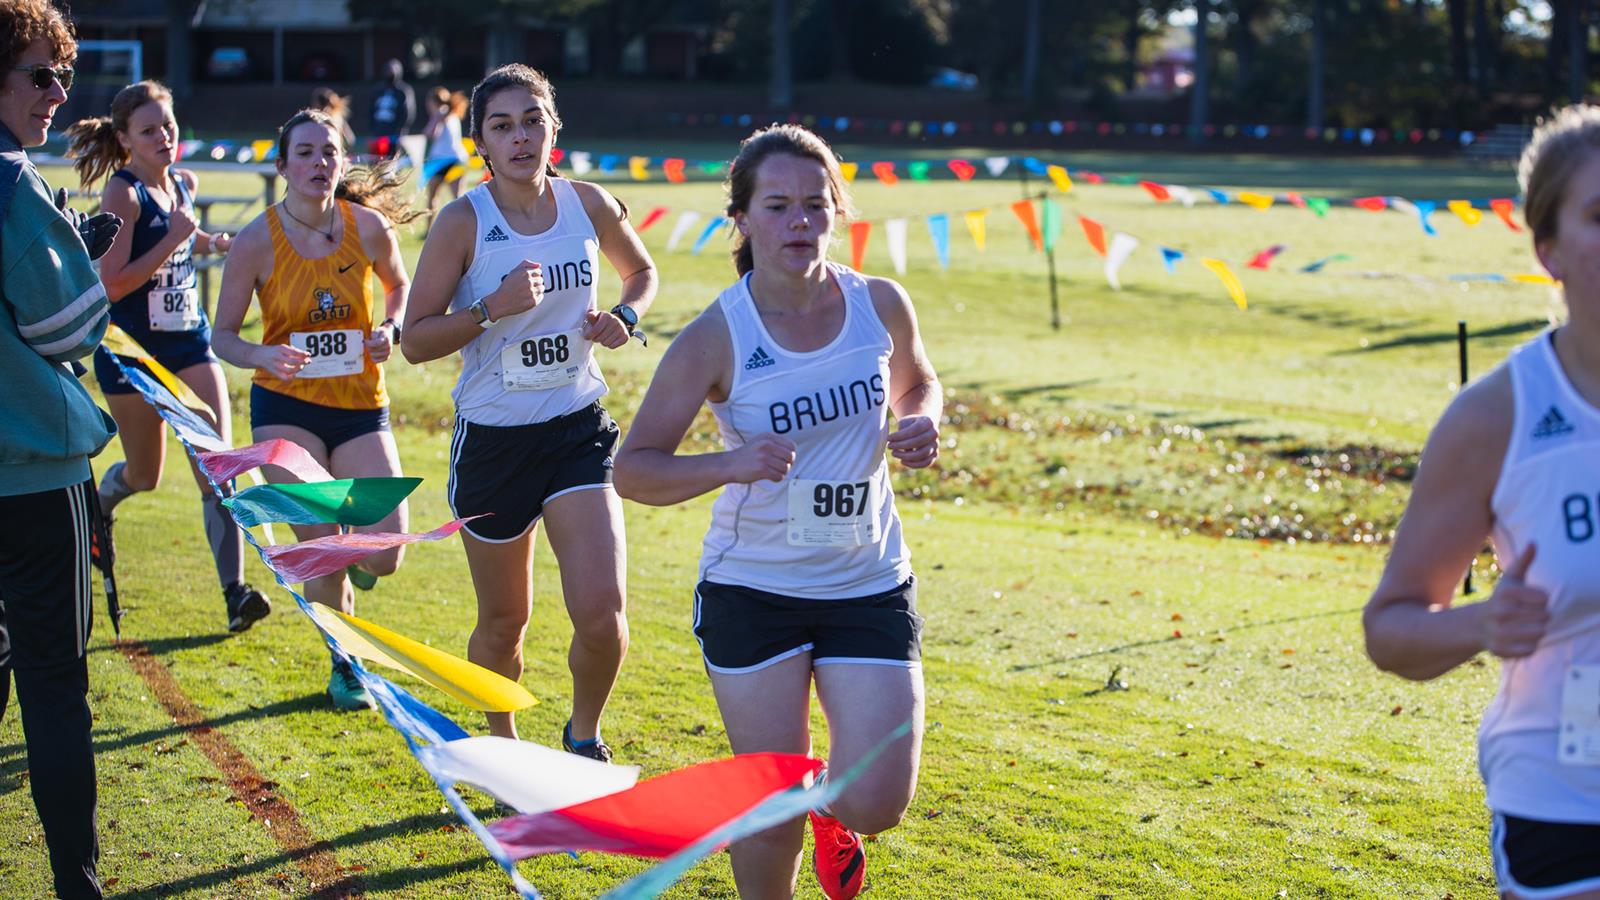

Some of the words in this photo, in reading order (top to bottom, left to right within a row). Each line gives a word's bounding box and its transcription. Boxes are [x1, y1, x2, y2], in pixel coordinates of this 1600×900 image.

[484, 234, 509, 242] adidas
[163, 292, 191, 313] 924
[305, 332, 347, 357] 938
[521, 335, 569, 367] 968
[744, 357, 775, 370] adidas
[769, 373, 885, 434] BRUINS
[813, 481, 870, 517] 967
[1562, 492, 1600, 543] B
